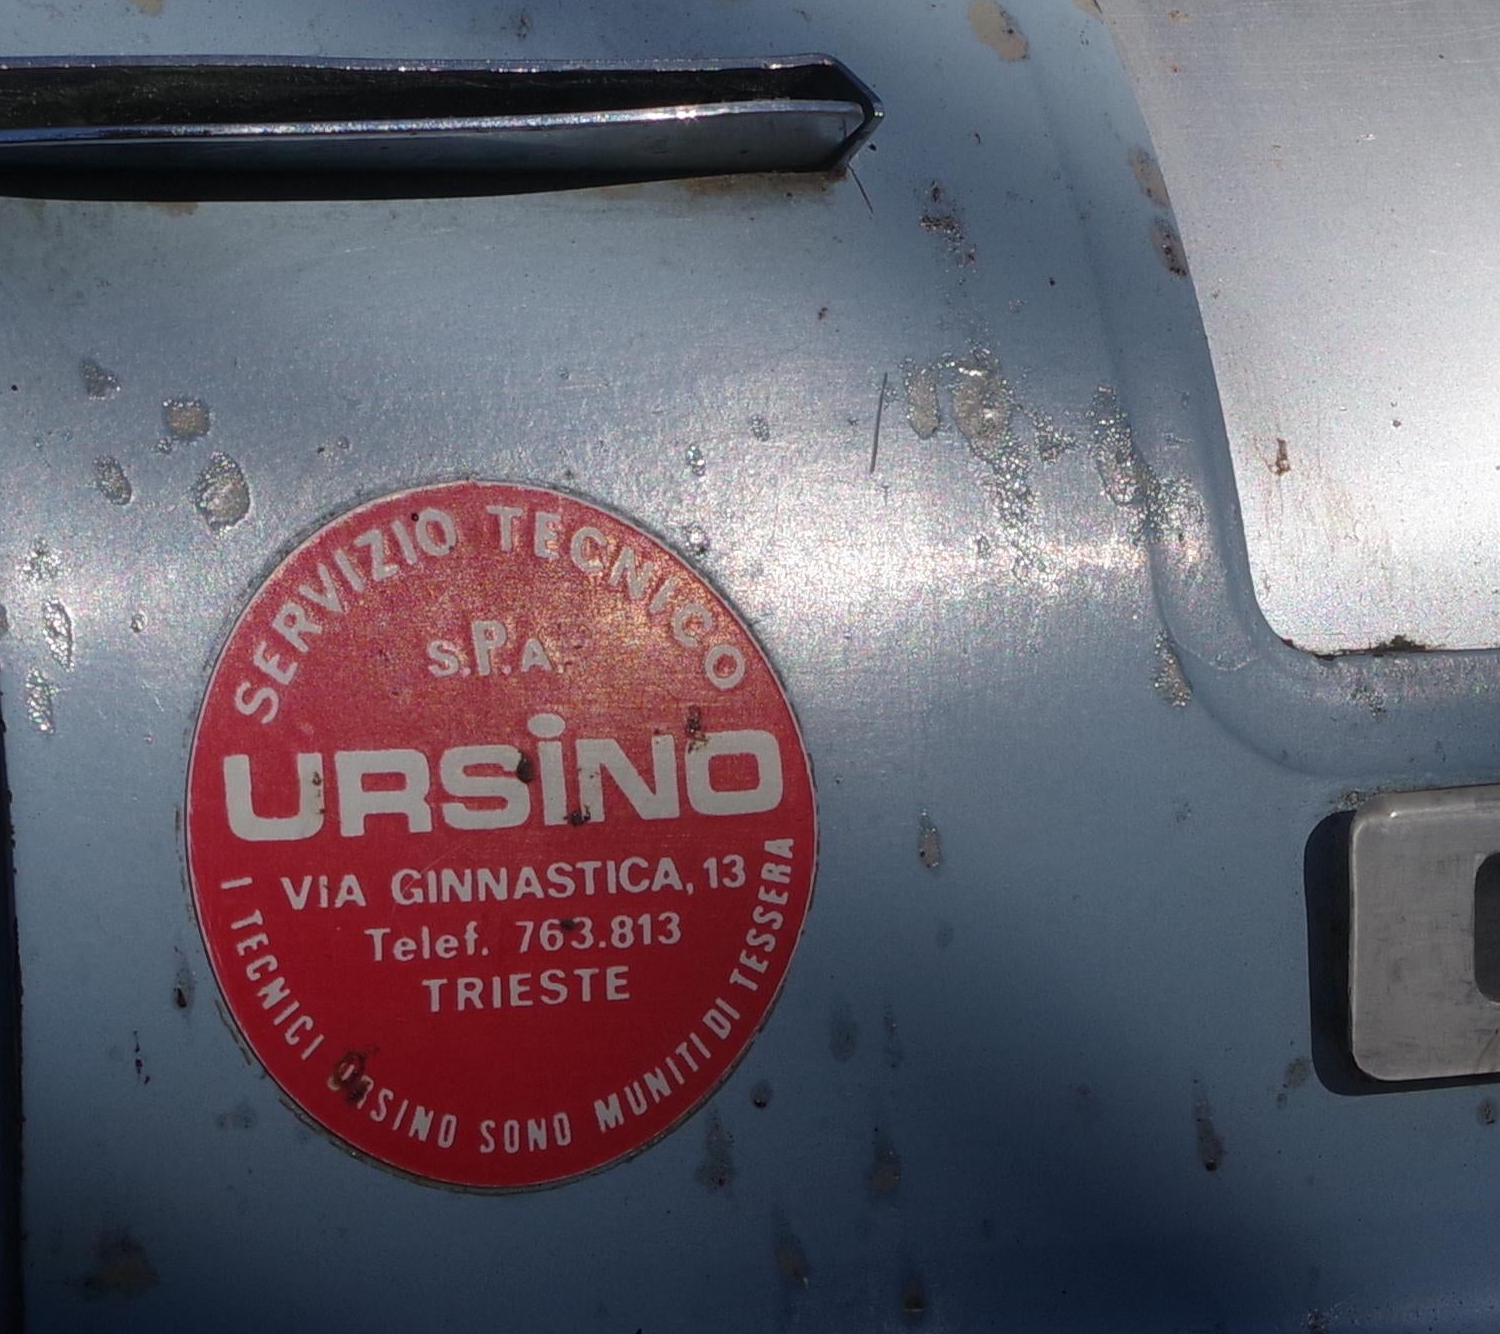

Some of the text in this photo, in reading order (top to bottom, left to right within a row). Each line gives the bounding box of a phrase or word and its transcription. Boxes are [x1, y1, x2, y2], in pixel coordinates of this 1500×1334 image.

[234, 504, 748, 724] SERVIZIO TECNICO
[426, 620, 565, 678] S.P.A.
[280, 854, 747, 911] VIA GINNASTICA, 13
[364, 911, 682, 962] Telef. 763.813
[230, 909, 325, 1061] TECNICI
[480, 1112, 572, 1154] SONO
[593, 1032, 712, 1133] MUNITI
[702, 996, 741, 1041] DI
[729, 837, 795, 992] TESSERA
[422, 966, 630, 1012] TRIESTE
